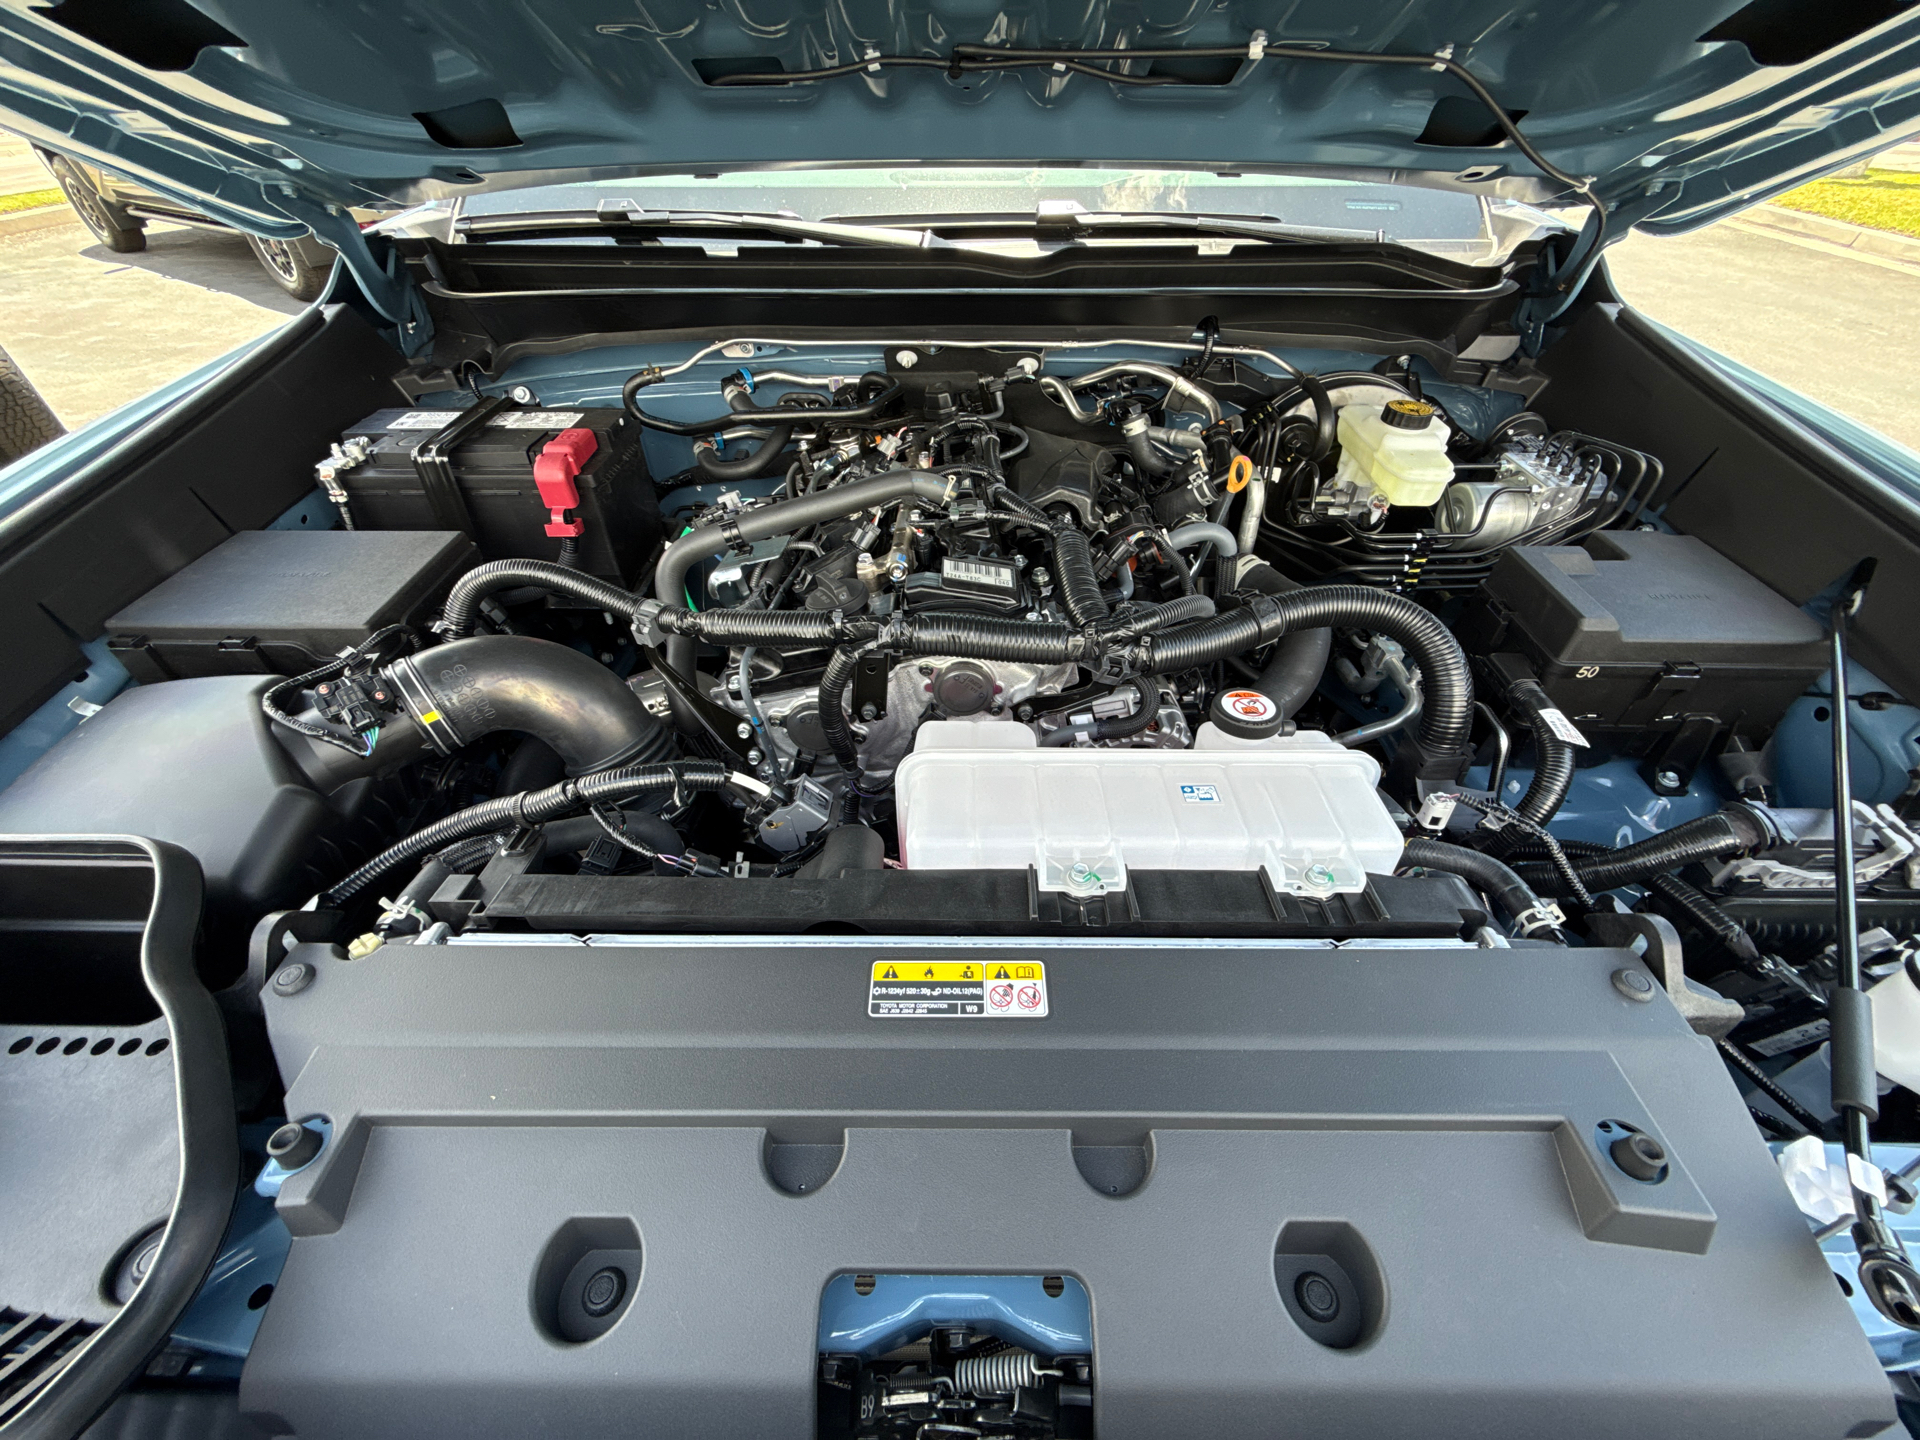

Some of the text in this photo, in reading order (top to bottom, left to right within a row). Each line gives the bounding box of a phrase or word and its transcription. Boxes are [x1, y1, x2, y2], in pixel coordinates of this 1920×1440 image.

[1575, 666, 1600, 678] 50
[881, 987, 906, 996] R-1234yf
[966, 1005, 978, 1013] W9
[860, 1394, 875, 1419] B9
